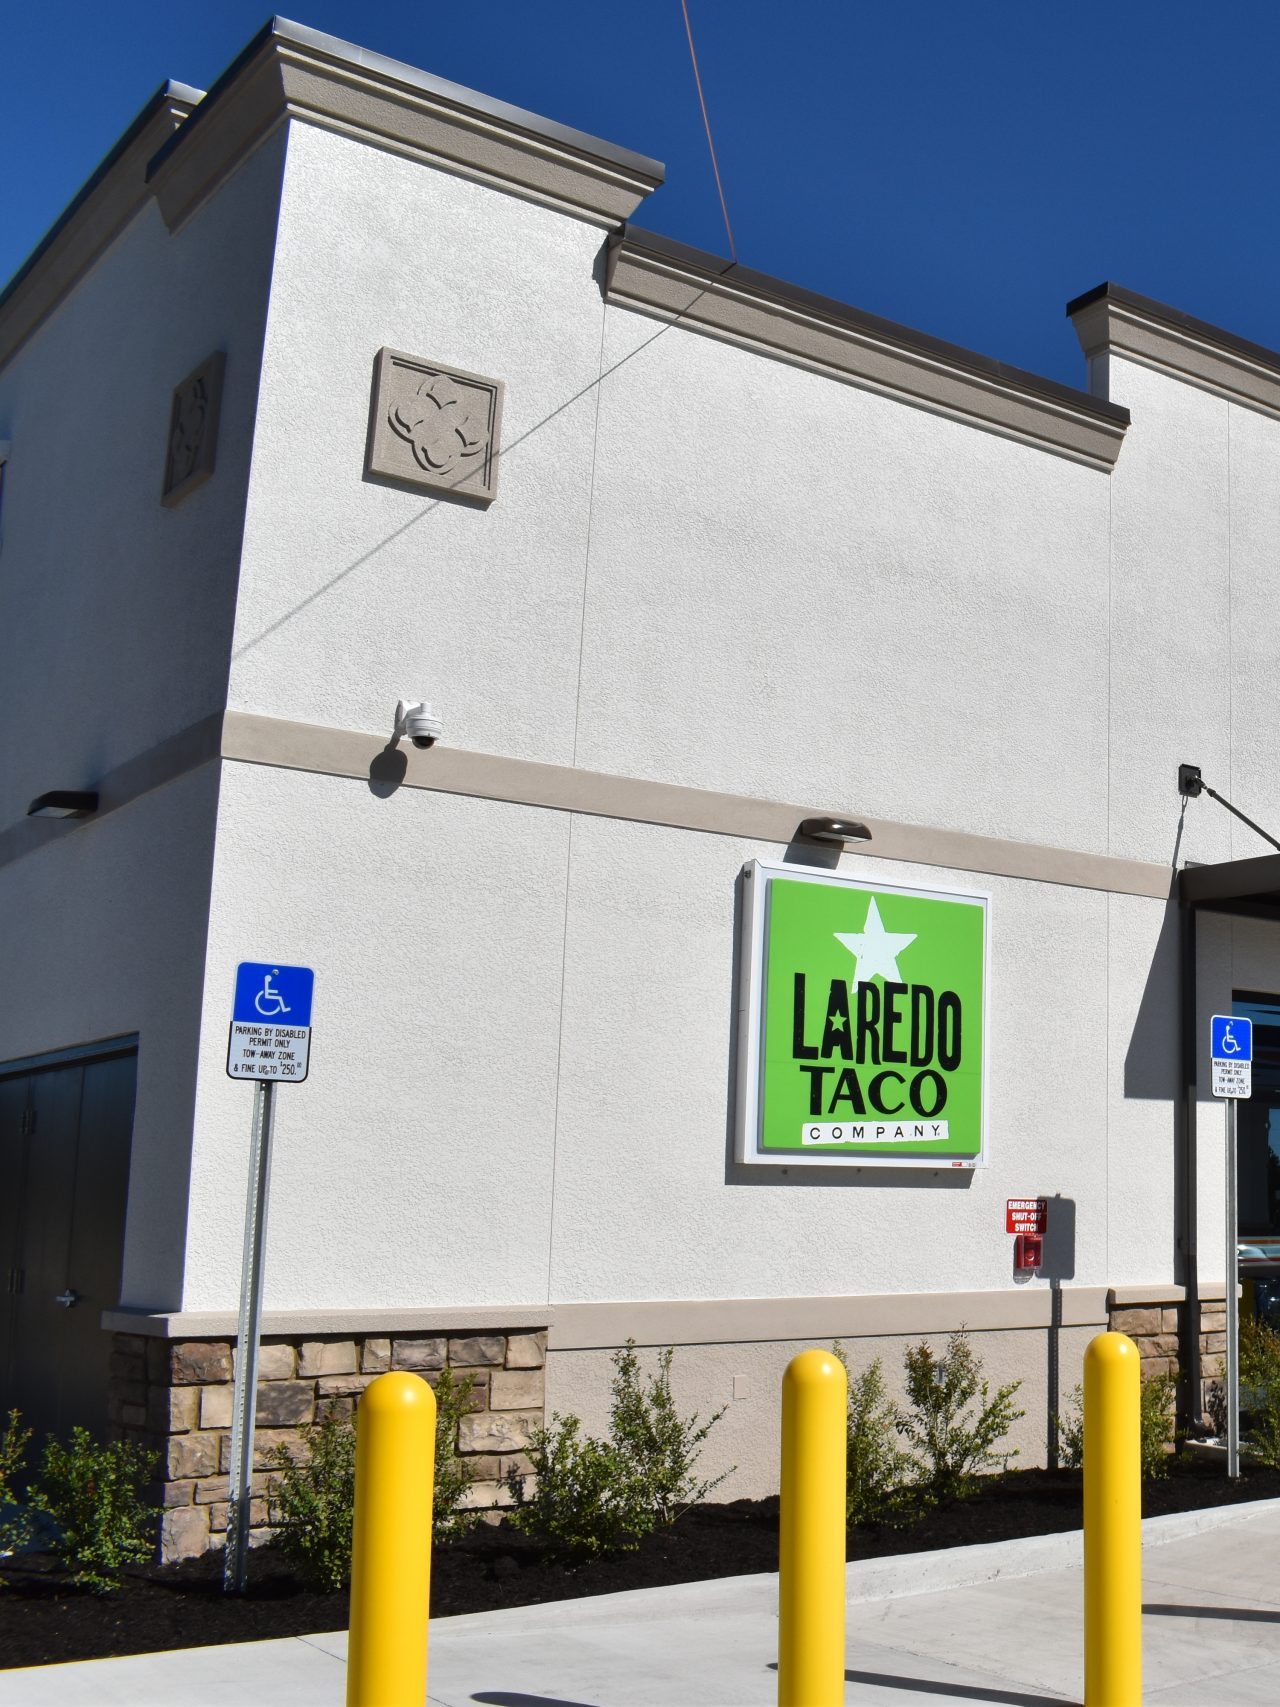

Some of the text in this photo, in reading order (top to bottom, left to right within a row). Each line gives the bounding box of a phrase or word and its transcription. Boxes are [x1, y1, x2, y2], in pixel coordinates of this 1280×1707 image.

[793, 972, 962, 1072] LAREDO
[235, 1026, 306, 1039] PARKING BY DISABLED
[249, 1037, 291, 1048] PERMIT ONLY
[243, 1049, 295, 1061] TOW-AWAY ZONE
[233, 1063, 239, 1072] &
[241, 1064, 256, 1073] FINE
[258, 1065, 267, 1074] UP
[270, 1065, 277, 1074] TO
[800, 1065, 948, 1118] TACO
[809, 1124, 940, 1140] COMPANY
[1008, 1200, 1045, 1210] EMERGENCY
[1011, 1211, 1042, 1221] SHUT-OFF
[1014, 1222, 1039, 1232] SWITCH
